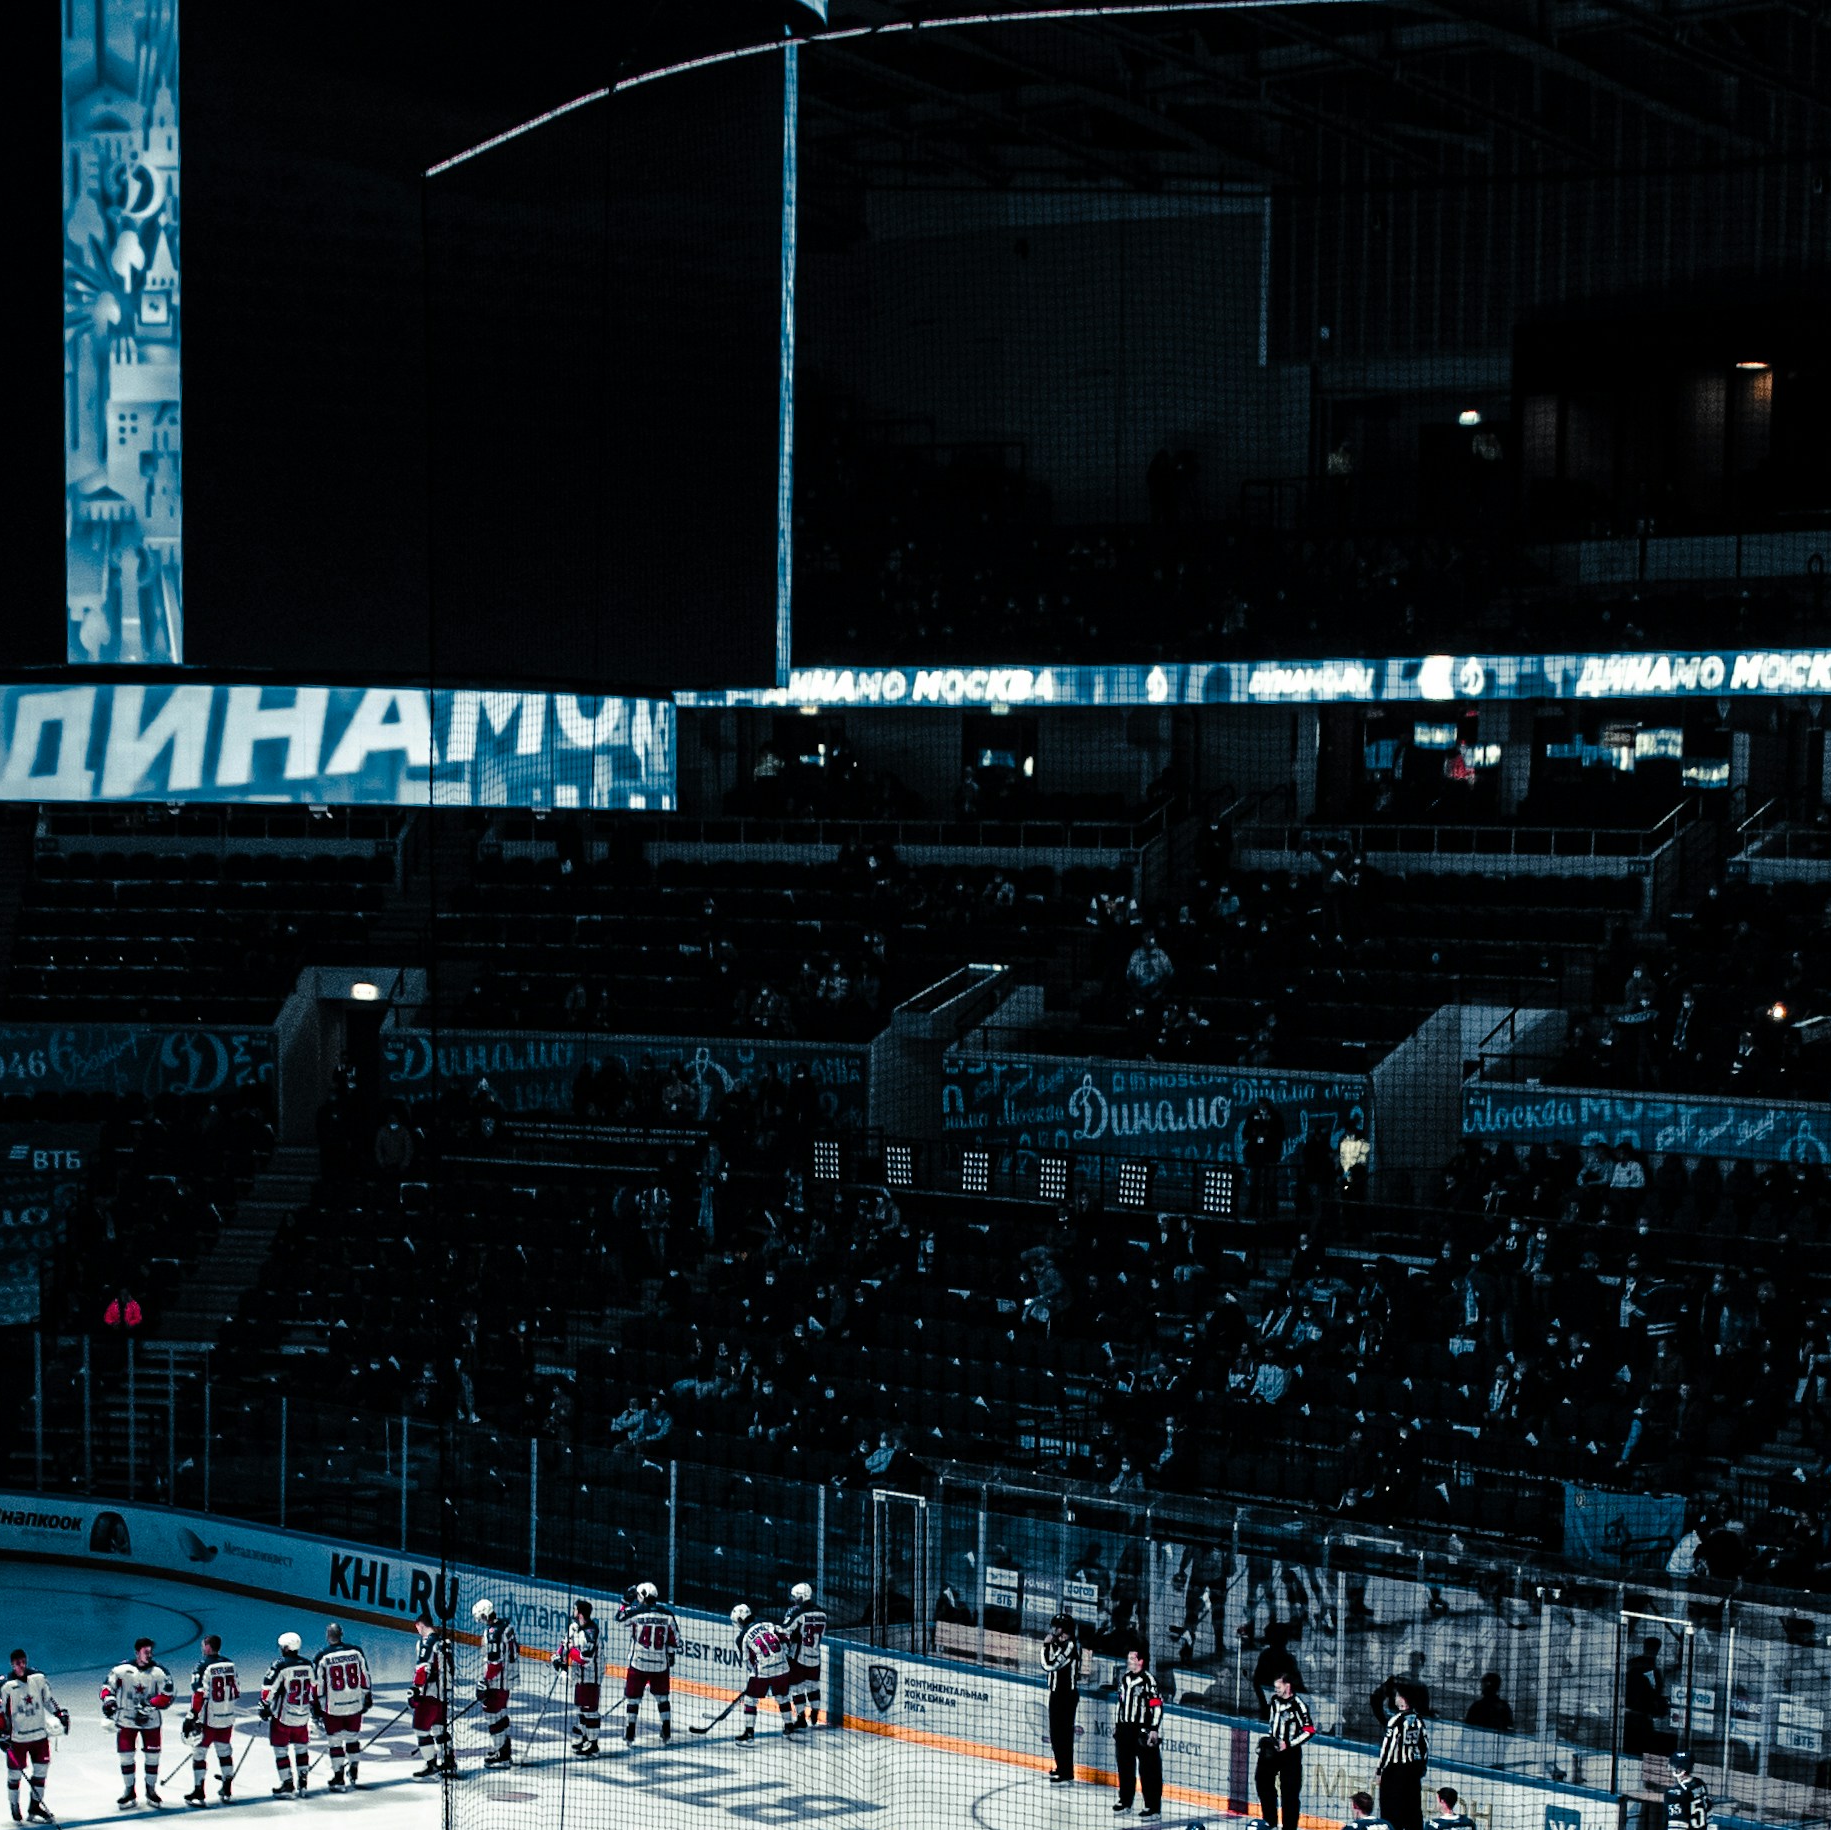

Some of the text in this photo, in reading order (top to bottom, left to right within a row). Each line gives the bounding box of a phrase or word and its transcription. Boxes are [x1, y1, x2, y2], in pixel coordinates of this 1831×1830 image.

[912, 669, 1053, 701] МОСКВА
[1576, 654, 1725, 696] ДИНАМО
[1069, 1073, 1234, 1141] Динамо
[32, 1147, 82, 1171] ВТБ
[329, 1552, 460, 1621] KHL.RU
[677, 1641, 744, 1669] BEST RUN
[329, 1663, 359, 1691] 88
[904, 1676, 989, 1703] КОНТИНЕНТАЛЬНАЯ
[904, 1689, 957, 1709] ХОККЕЙНАЯ
[904, 1700, 927, 1715] ЛИГА
